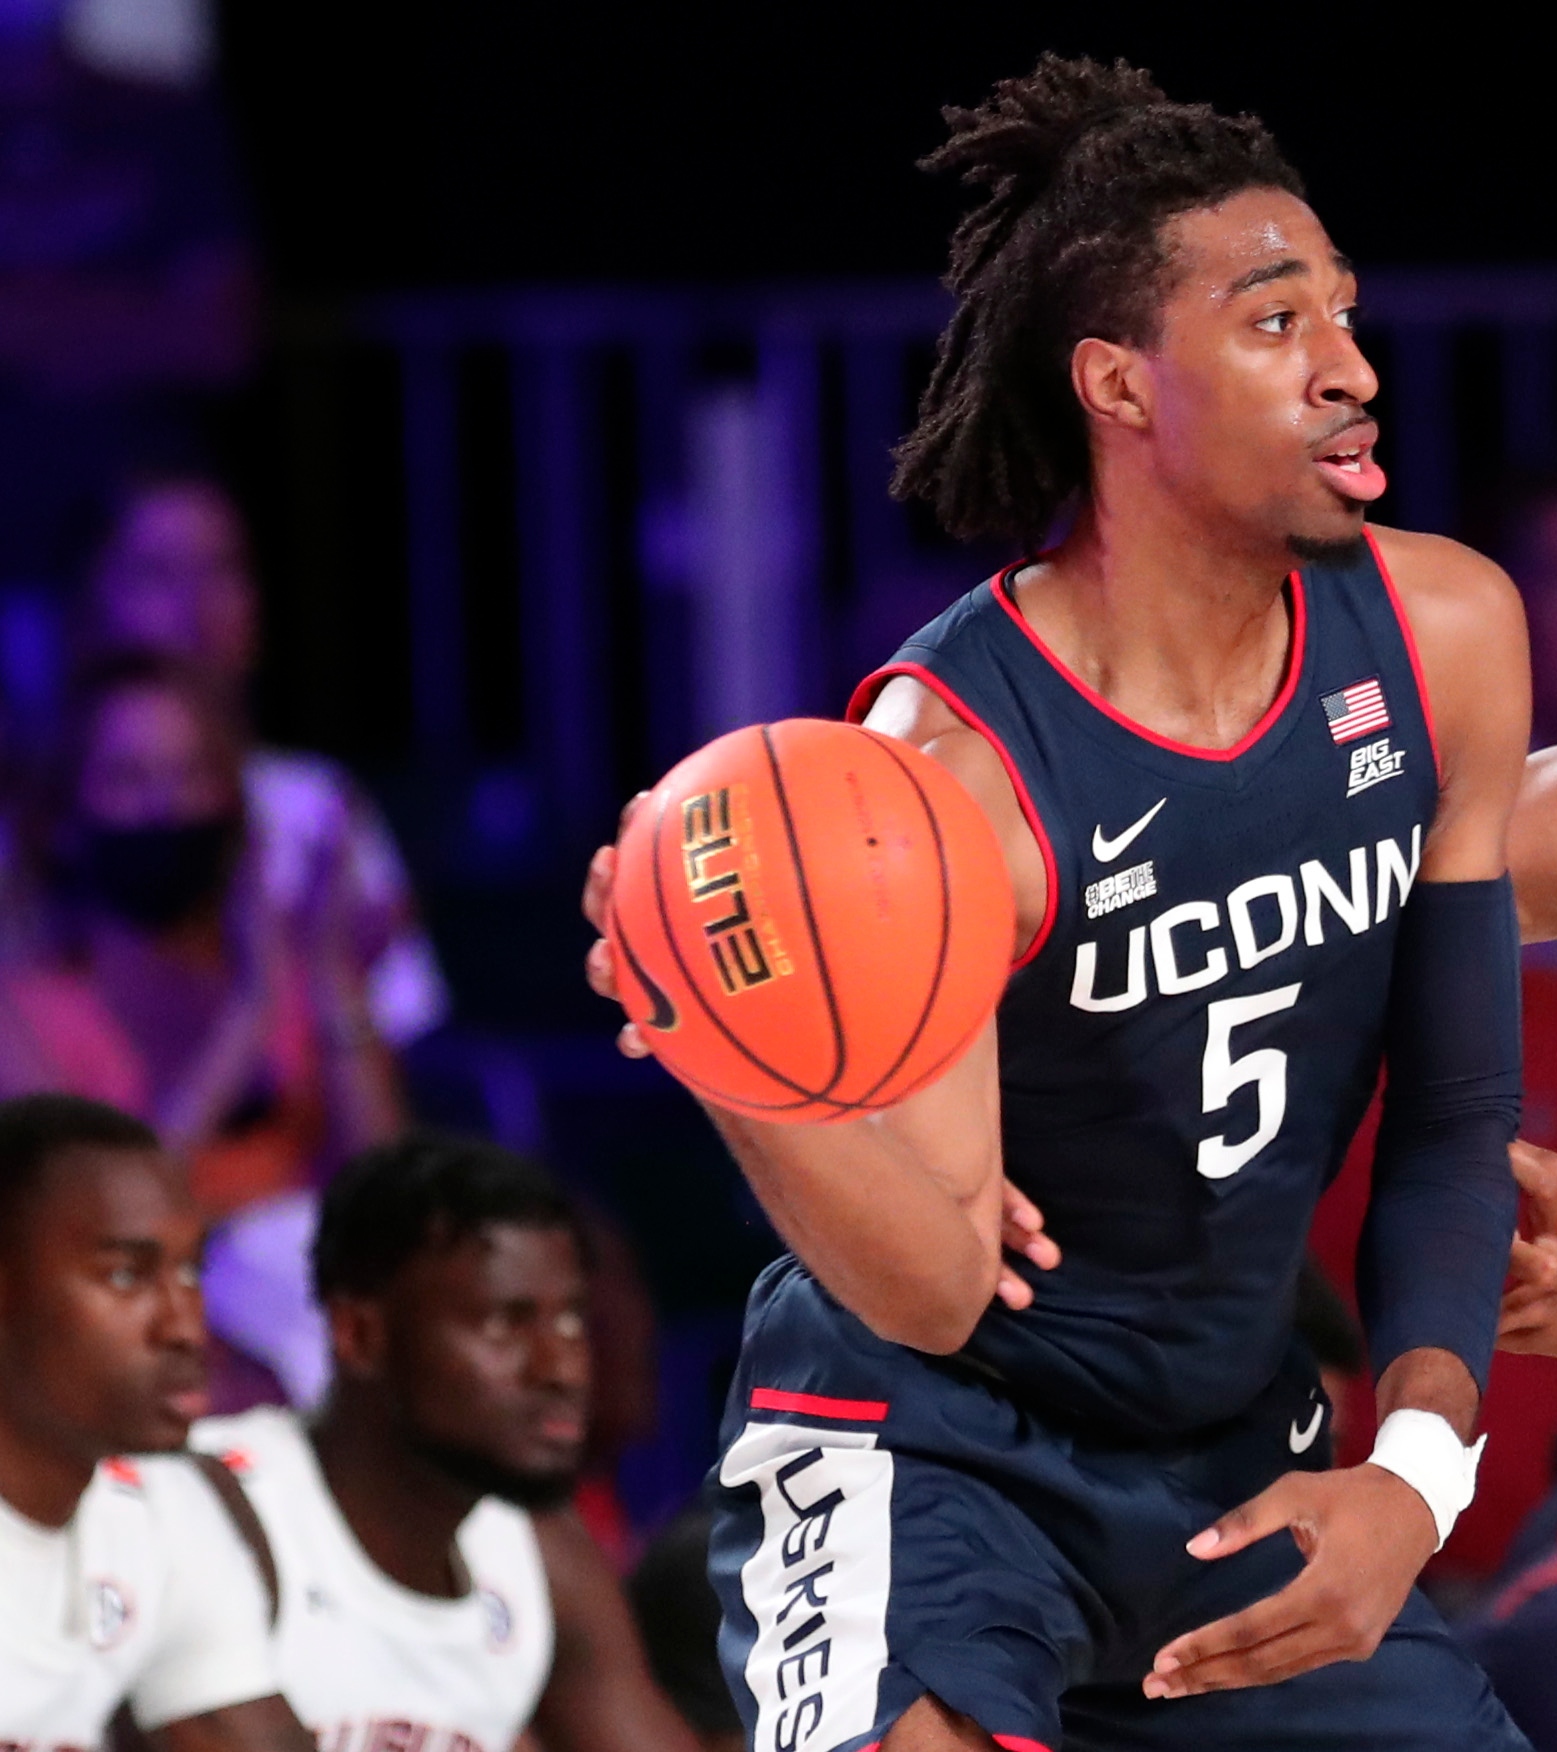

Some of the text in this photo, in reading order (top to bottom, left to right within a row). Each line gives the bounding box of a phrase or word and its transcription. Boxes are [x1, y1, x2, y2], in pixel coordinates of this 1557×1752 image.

[1348, 750, 1406, 788] EAST
[1350, 738, 1390, 770] BIG
[681, 787, 774, 996] ELITE
[1069, 824, 1422, 1013] UCONN
[1087, 879, 1157, 919] CHANGE
[1196, 982, 1302, 1179] 5
[775, 1446, 847, 1752] USKIES
